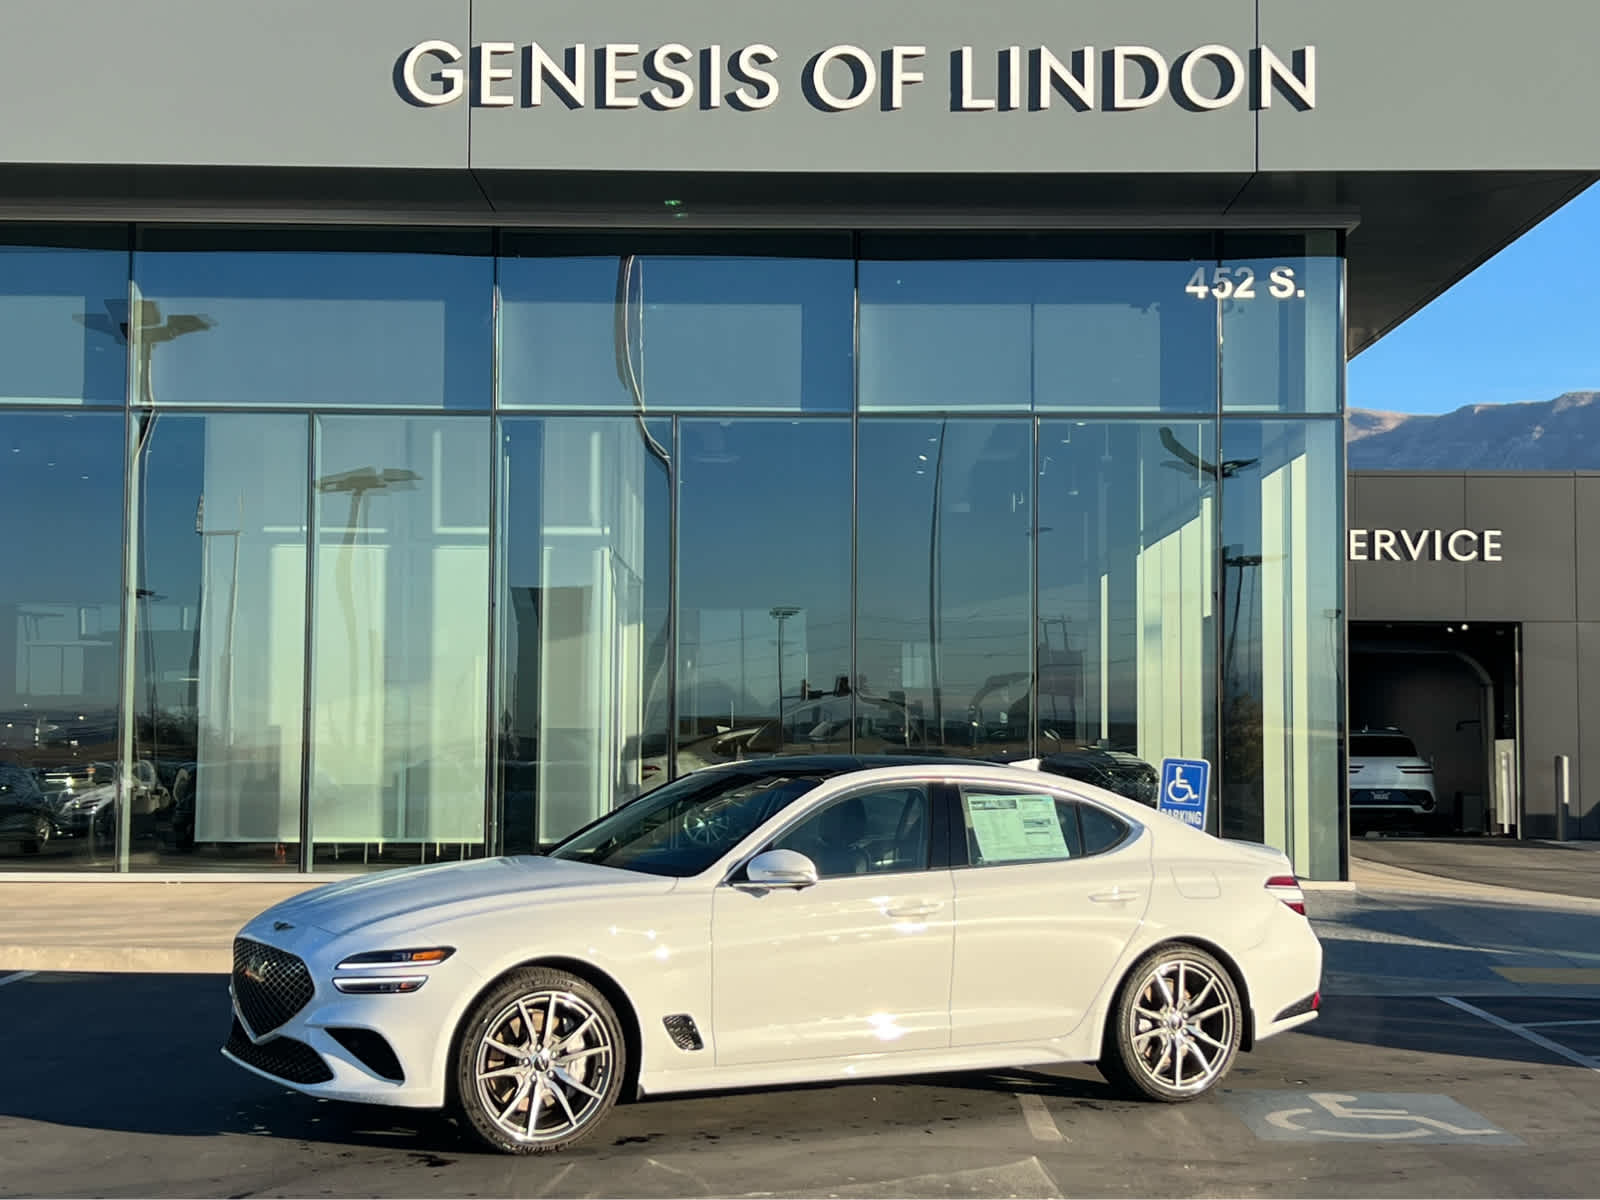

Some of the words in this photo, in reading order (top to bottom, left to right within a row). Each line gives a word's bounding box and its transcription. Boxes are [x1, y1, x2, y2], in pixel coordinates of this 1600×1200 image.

[403, 39, 780, 109] GENESIS
[812, 44, 927, 110] OF
[960, 44, 1317, 110] LINDON
[1185, 266, 1256, 299] 452
[1268, 265, 1305, 299] S.
[1349, 529, 1503, 562] ERVICE
